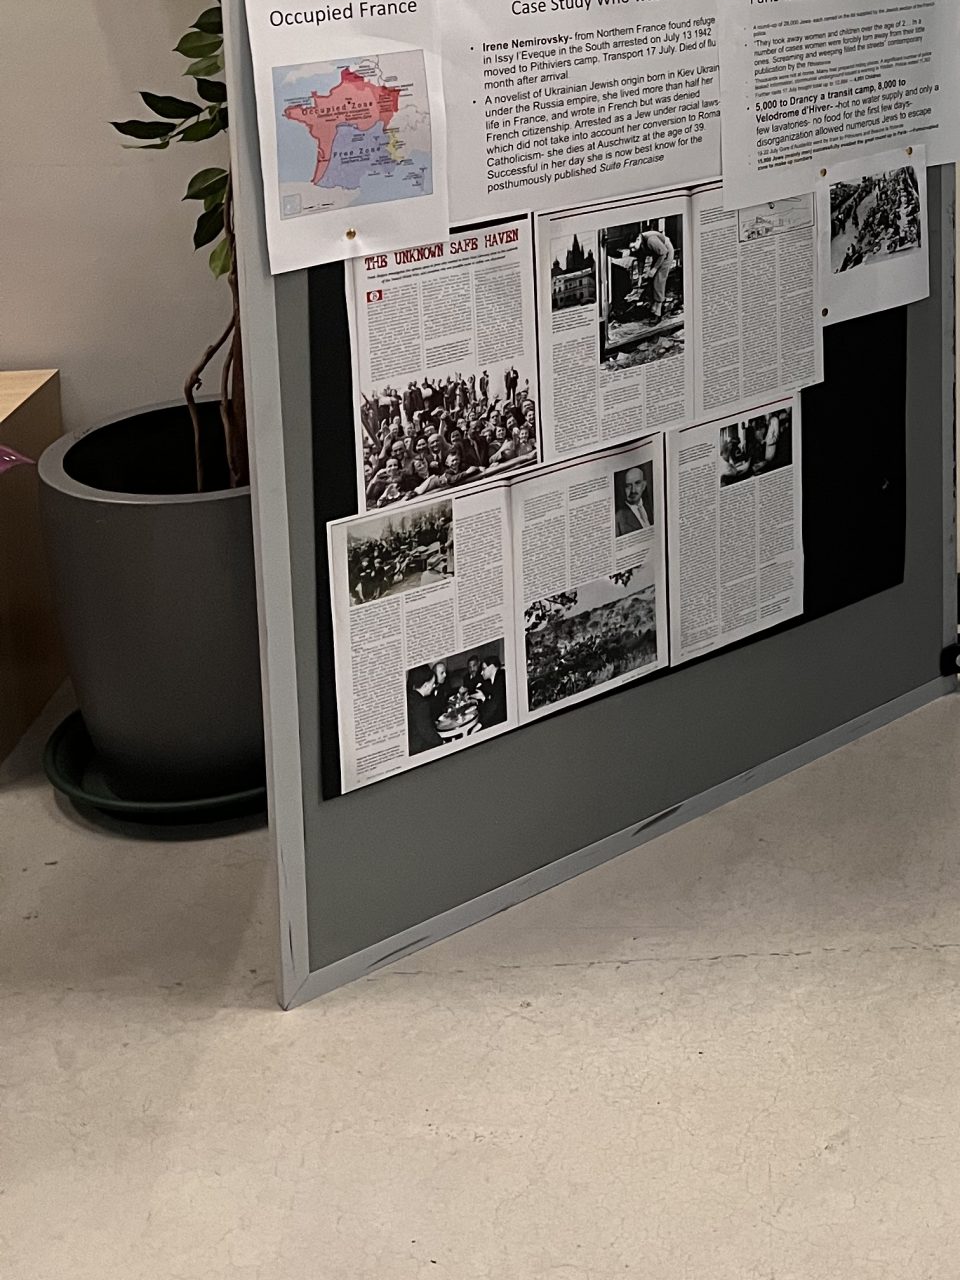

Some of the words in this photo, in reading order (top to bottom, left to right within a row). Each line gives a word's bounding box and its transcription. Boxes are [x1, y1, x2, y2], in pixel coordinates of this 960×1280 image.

[269, 2, 353, 26] Occupied
[359, 0, 417, 17] France
[511, 0, 547, 15] Case
[364, 254, 388, 271] THE
[394, 243, 444, 265] UNKNOWN
[449, 237, 479, 254] SAFE
[484, 228, 519, 249] HAVEN
